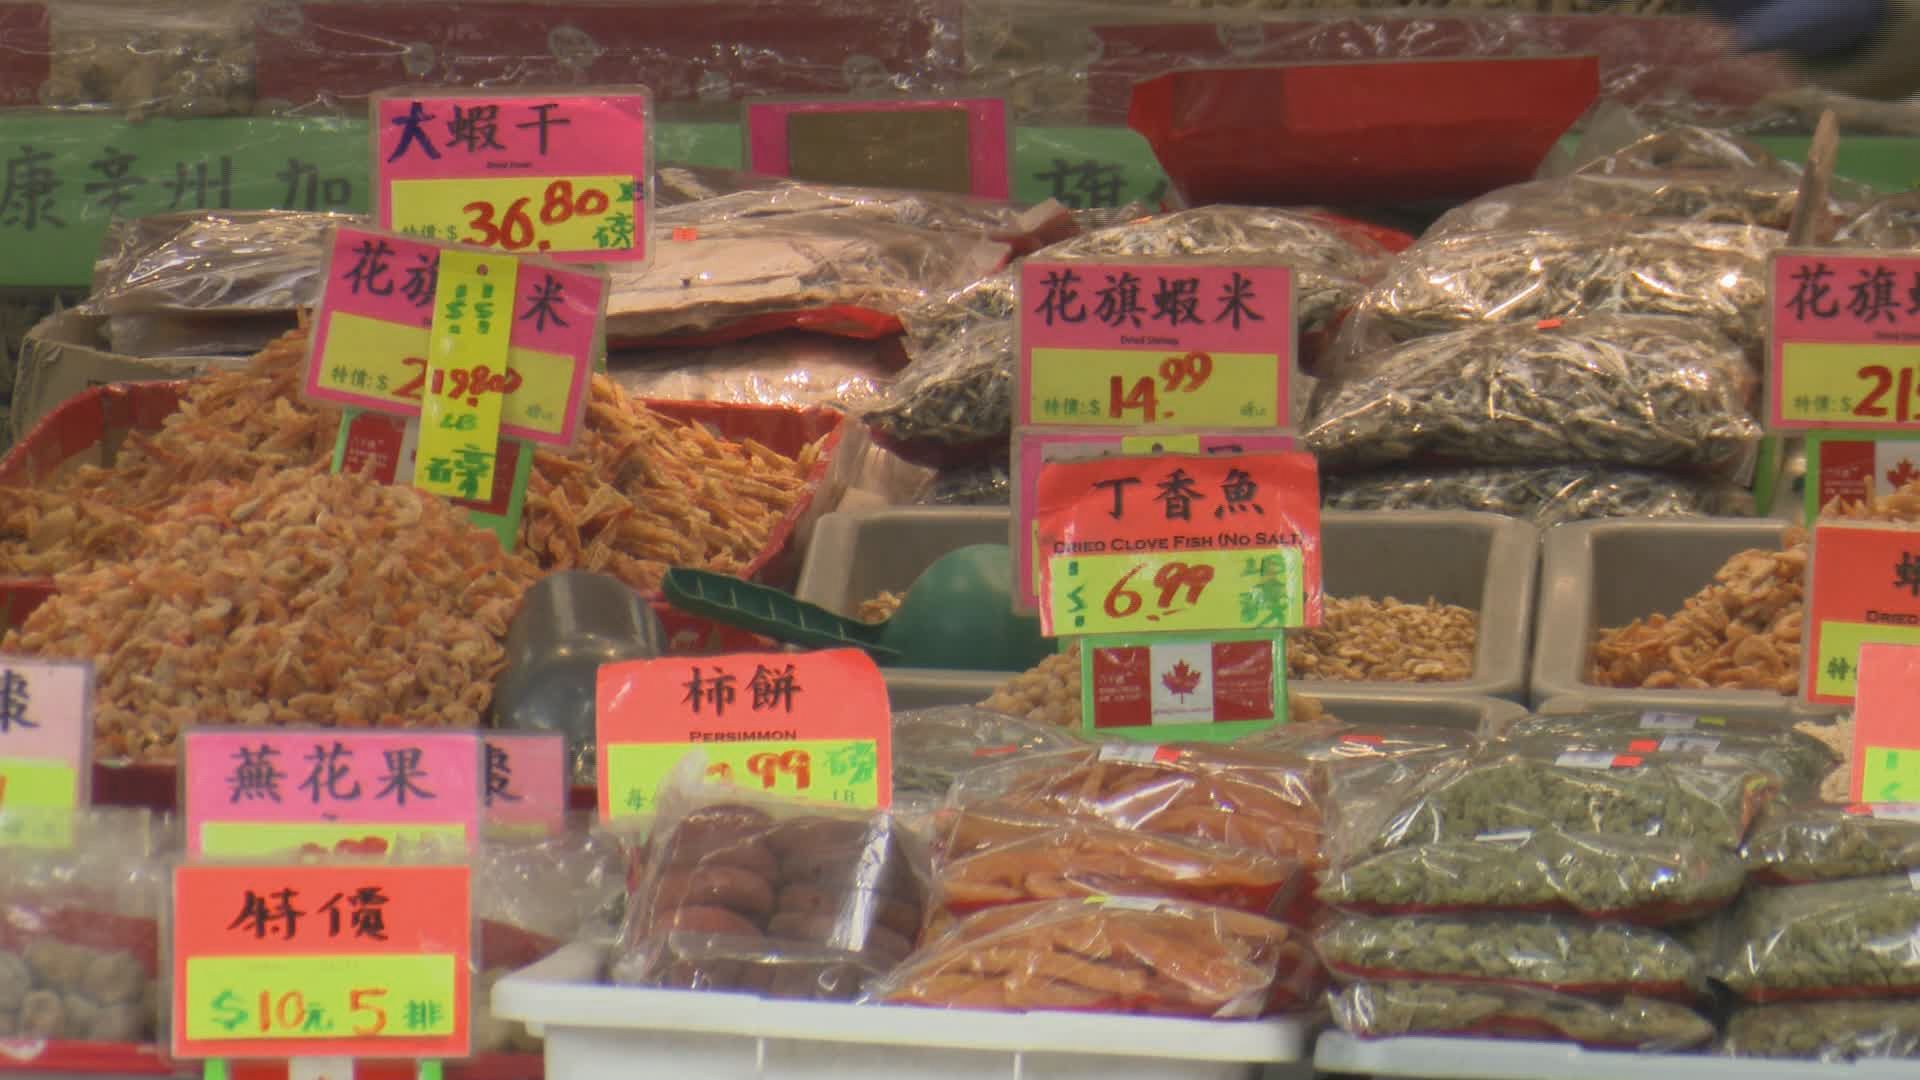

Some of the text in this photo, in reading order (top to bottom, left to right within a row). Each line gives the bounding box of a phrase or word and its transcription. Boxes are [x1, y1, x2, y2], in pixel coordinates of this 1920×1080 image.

[387, 101, 572, 163] 大蝦干
[462, 179, 610, 250] 36.80
[1035, 269, 1265, 330] 花旗蝦米
[1784, 264, 1920, 324] 花旗
[1107, 351, 1214, 423] 14.99
[1853, 365, 1920, 422] 21
[1092, 468, 1265, 521] 丁香魚
[1111, 537, 1169, 551] CLOVE
[1173, 535, 1213, 548] FISH
[681, 663, 803, 717] 柿餅
[689, 730, 797, 742] PERSIMMON
[226, 886, 391, 941] 特價
